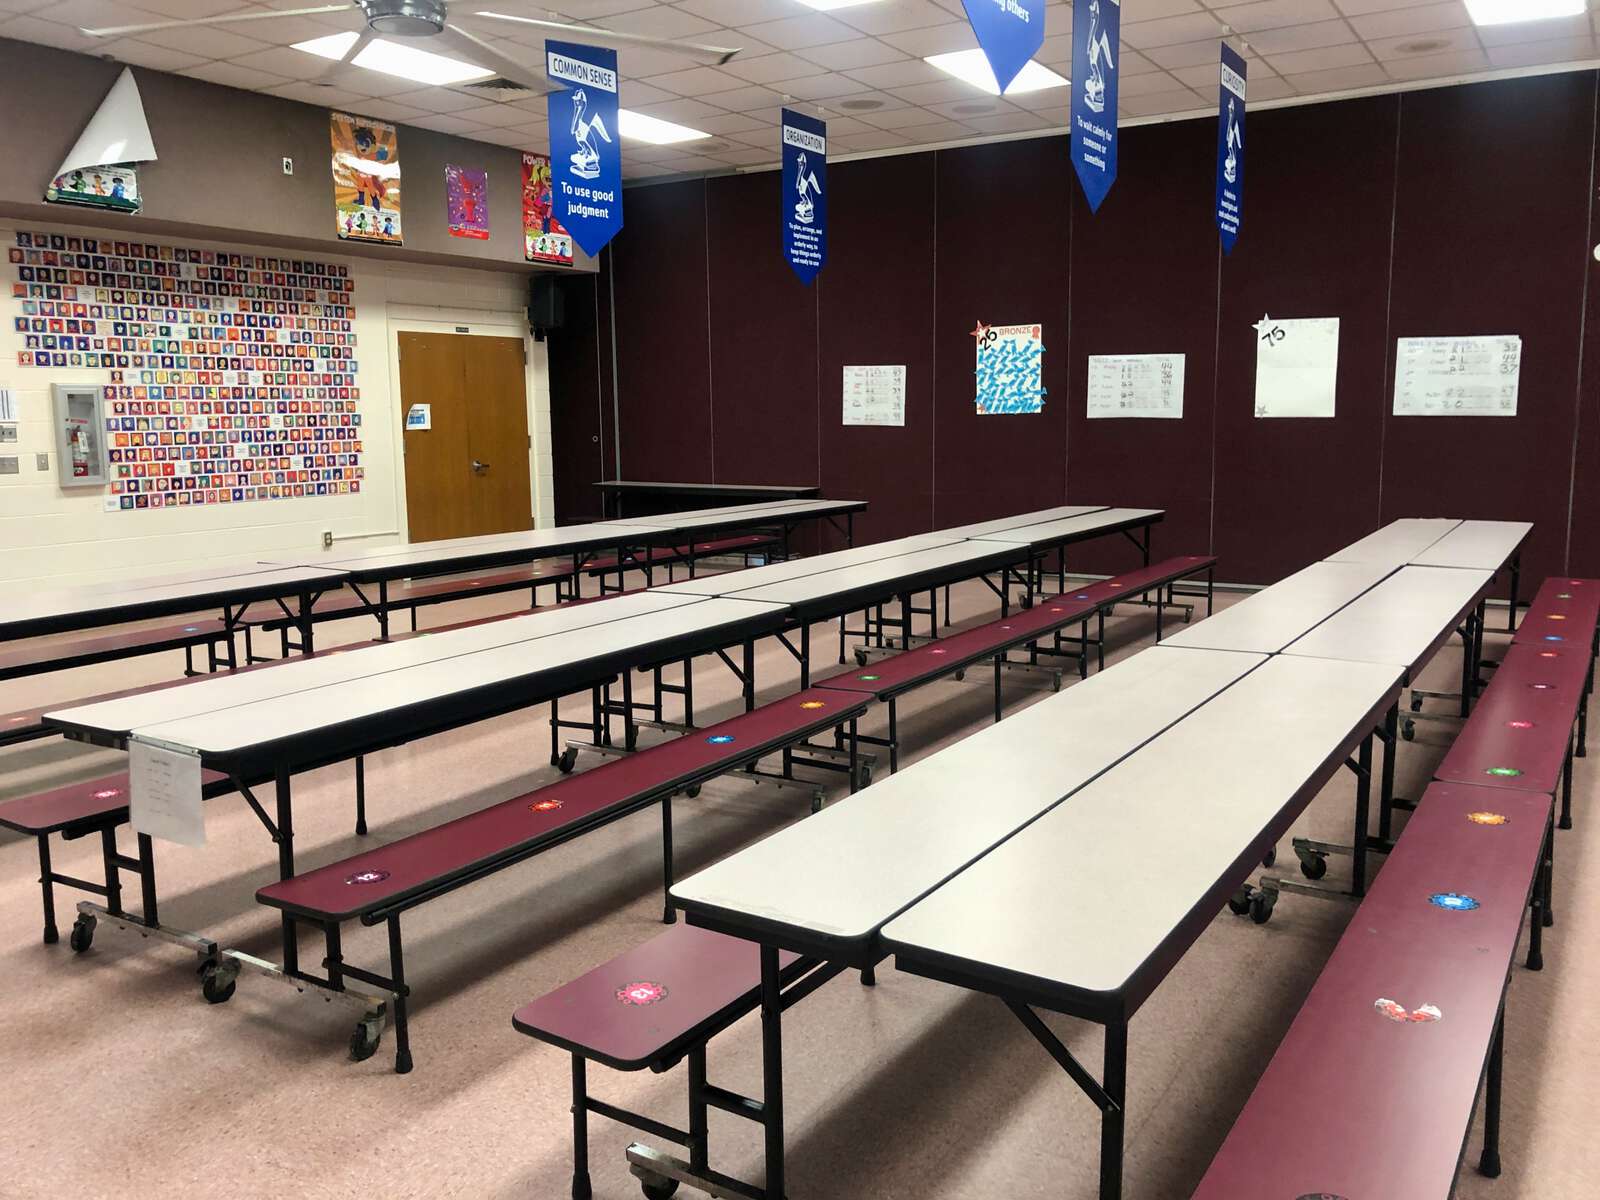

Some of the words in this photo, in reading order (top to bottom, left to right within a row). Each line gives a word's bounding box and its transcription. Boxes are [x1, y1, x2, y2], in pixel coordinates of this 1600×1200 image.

[553, 57, 588, 81] COMMON
[589, 68, 612, 88] SENSE
[1077, 114, 1083, 128] To
[786, 129, 822, 149] ORGANIZATION
[1083, 136, 1101, 152] someone
[1084, 153, 1105, 172] something
[560, 181, 573, 195] To
[574, 186, 591, 198] use
[592, 190, 614, 203] good
[567, 200, 609, 219] judgment
[979, 329, 998, 351] 25
[999, 326, 1031, 336] BRONZE
[1261, 325, 1286, 349] 75
